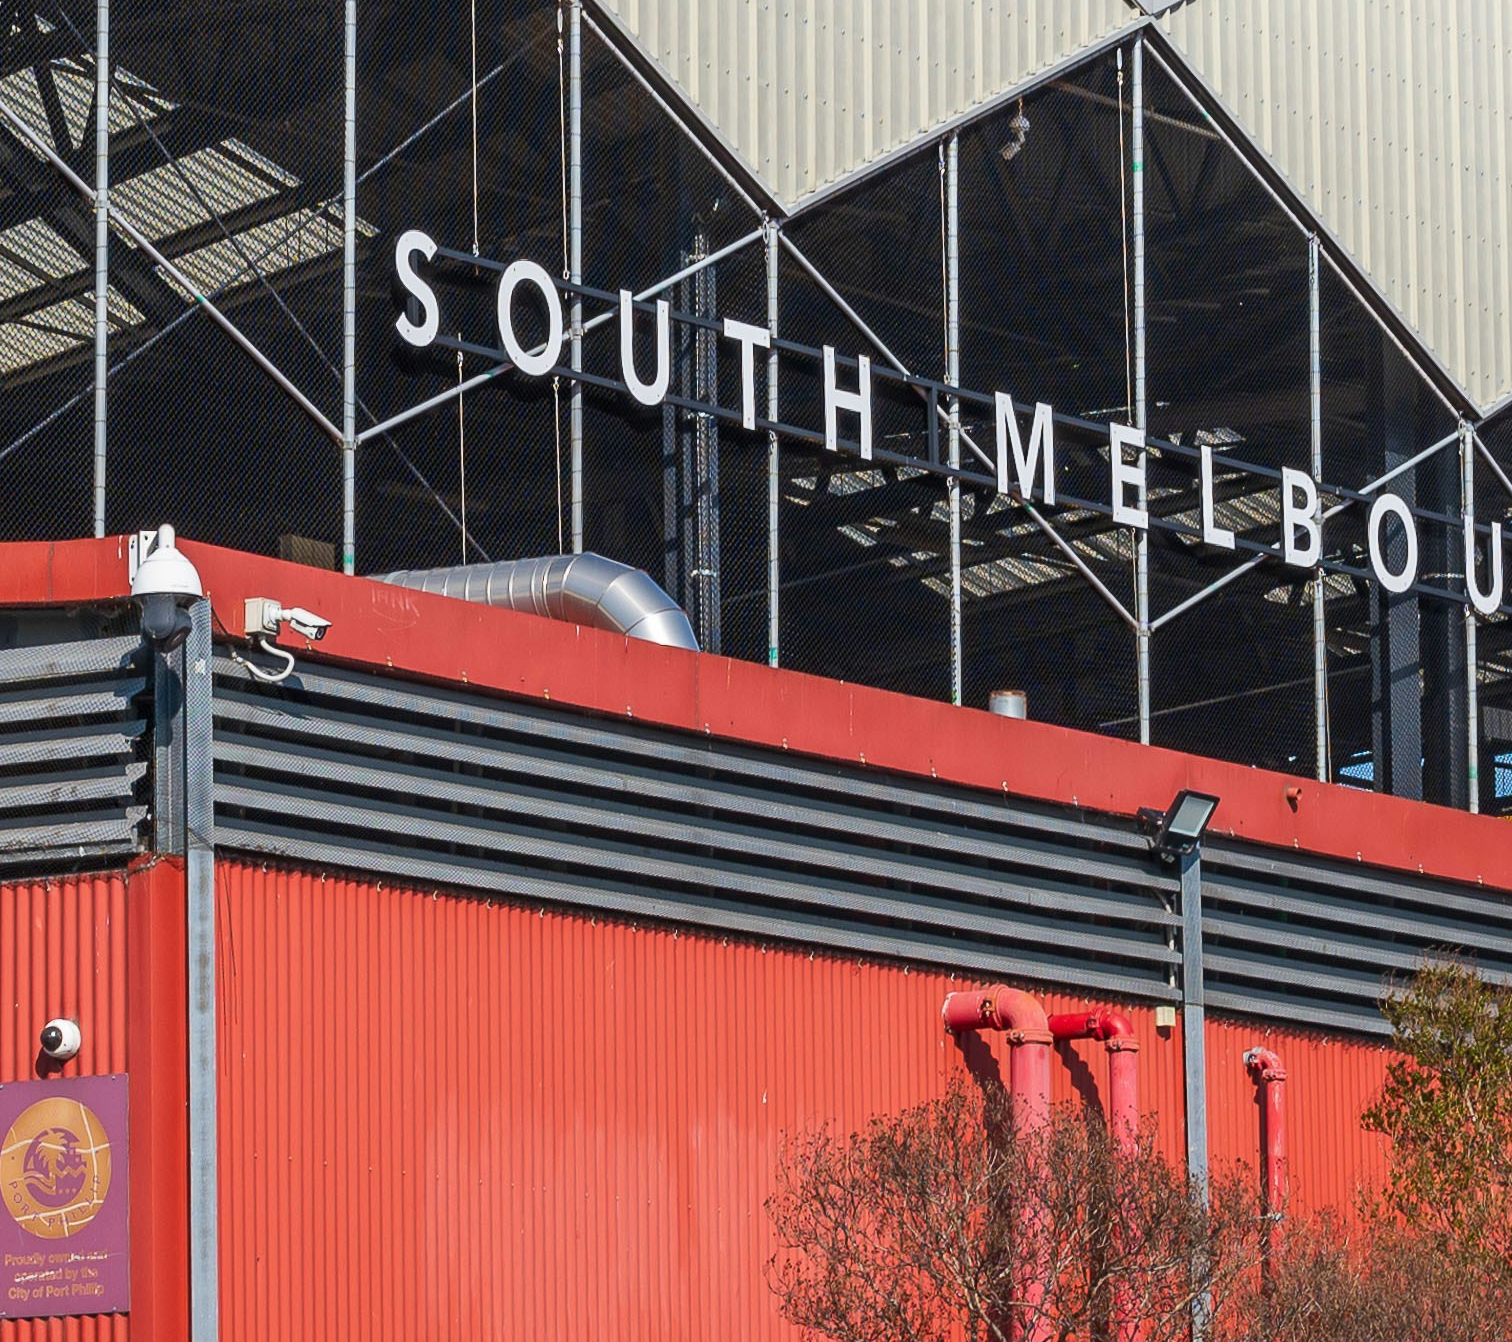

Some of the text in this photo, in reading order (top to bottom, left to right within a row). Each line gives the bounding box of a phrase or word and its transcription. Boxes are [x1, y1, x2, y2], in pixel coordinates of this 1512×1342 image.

[394, 230, 873, 460] SOUTH
[9, 1180, 39, 1223] PORT
[4, 1252, 46, 1266] Proudly
[65, 1268, 78, 1281] by
[8, 1283, 105, 1301] City of Port Phillip
